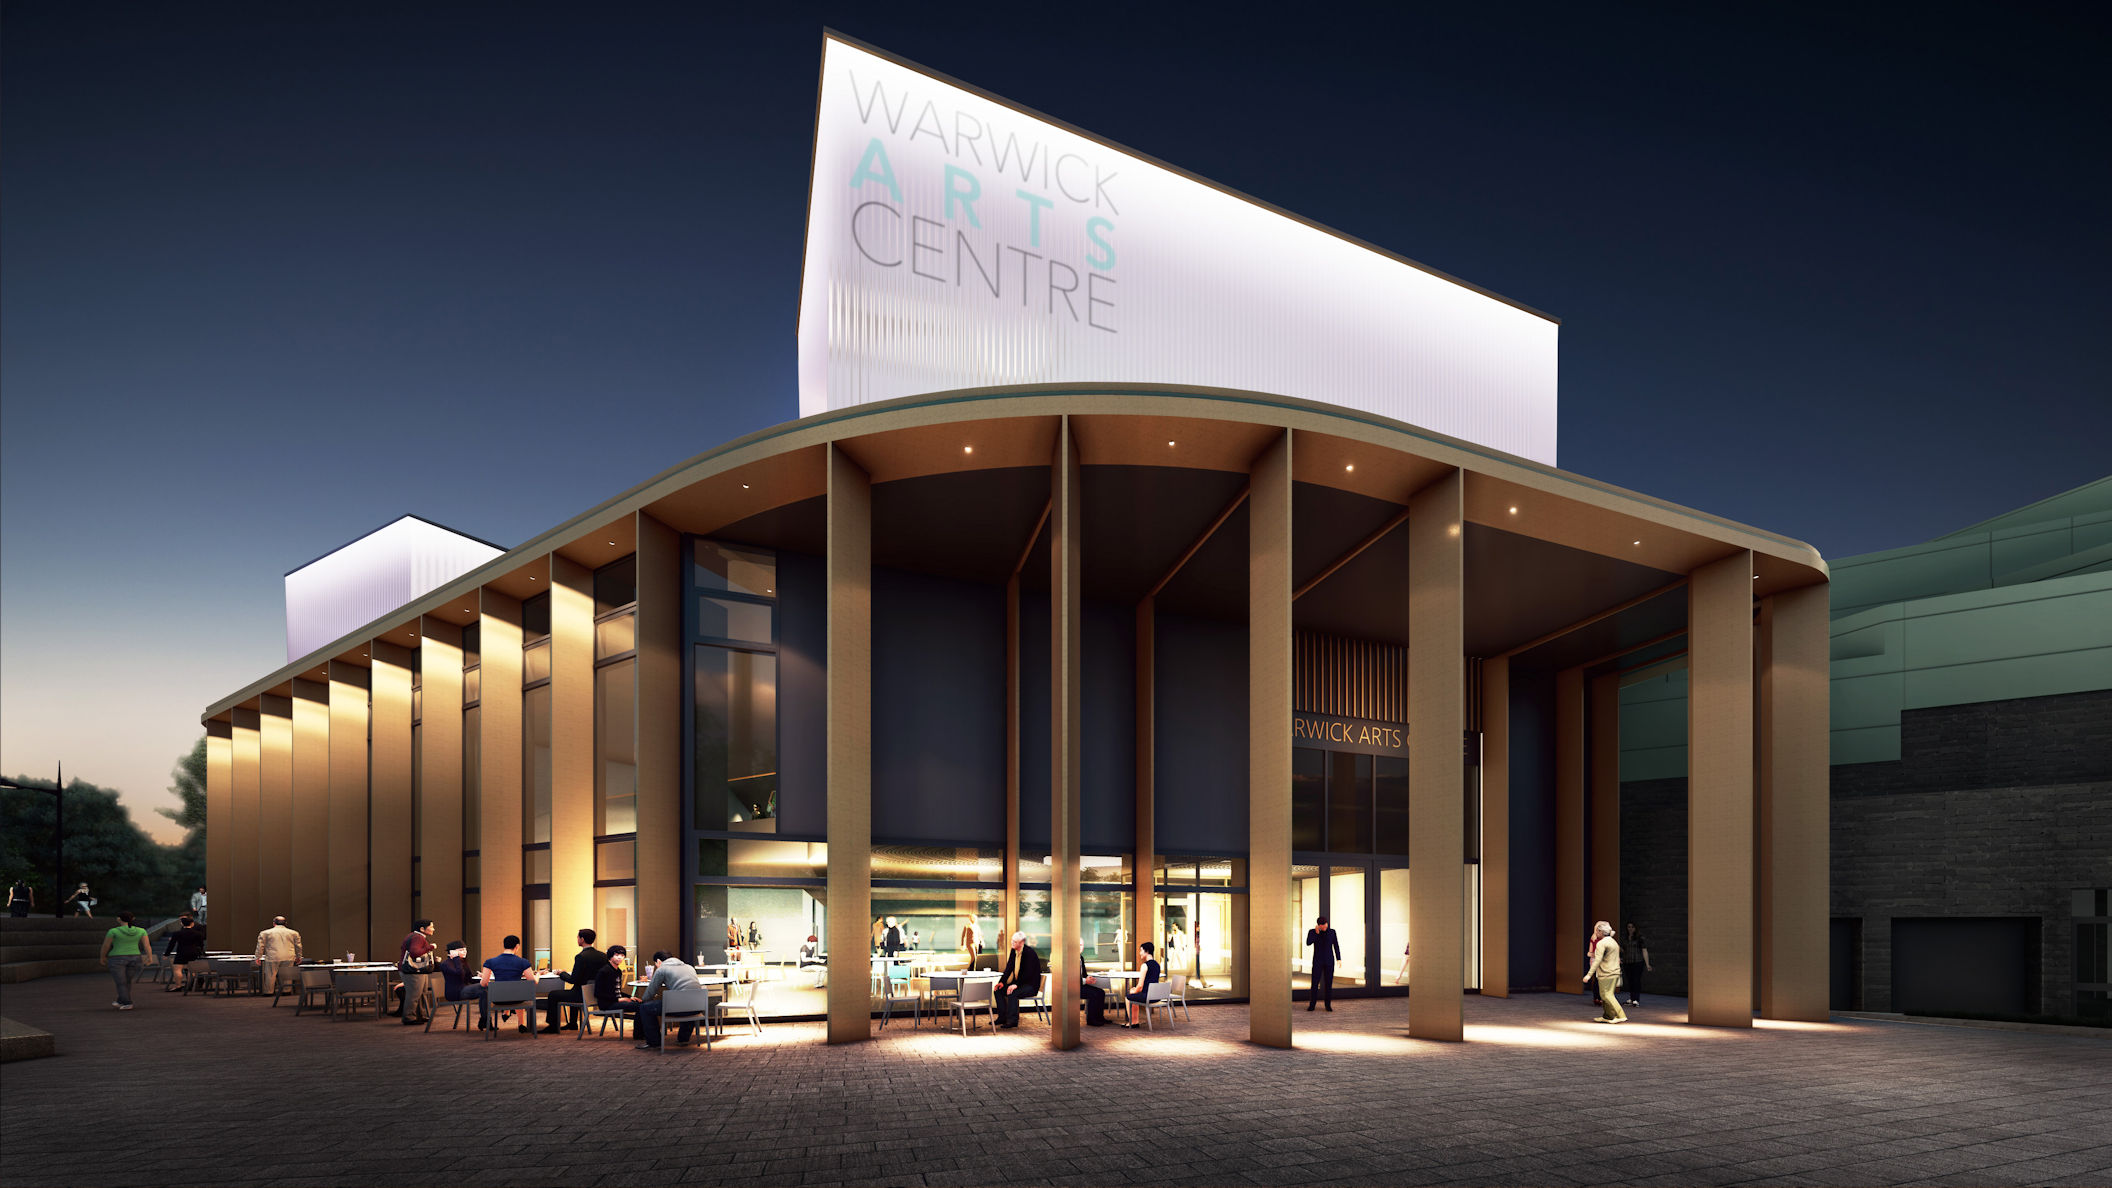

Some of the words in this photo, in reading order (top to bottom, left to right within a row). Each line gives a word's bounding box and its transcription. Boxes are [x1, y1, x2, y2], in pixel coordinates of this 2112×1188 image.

[848, 137, 1116, 271] ARTS
[849, 69, 1119, 216] WARWICK
[851, 200, 1118, 333] CENTRE
[1292, 718, 1353, 743] RWICK
[1358, 726, 1401, 748] ARTS
